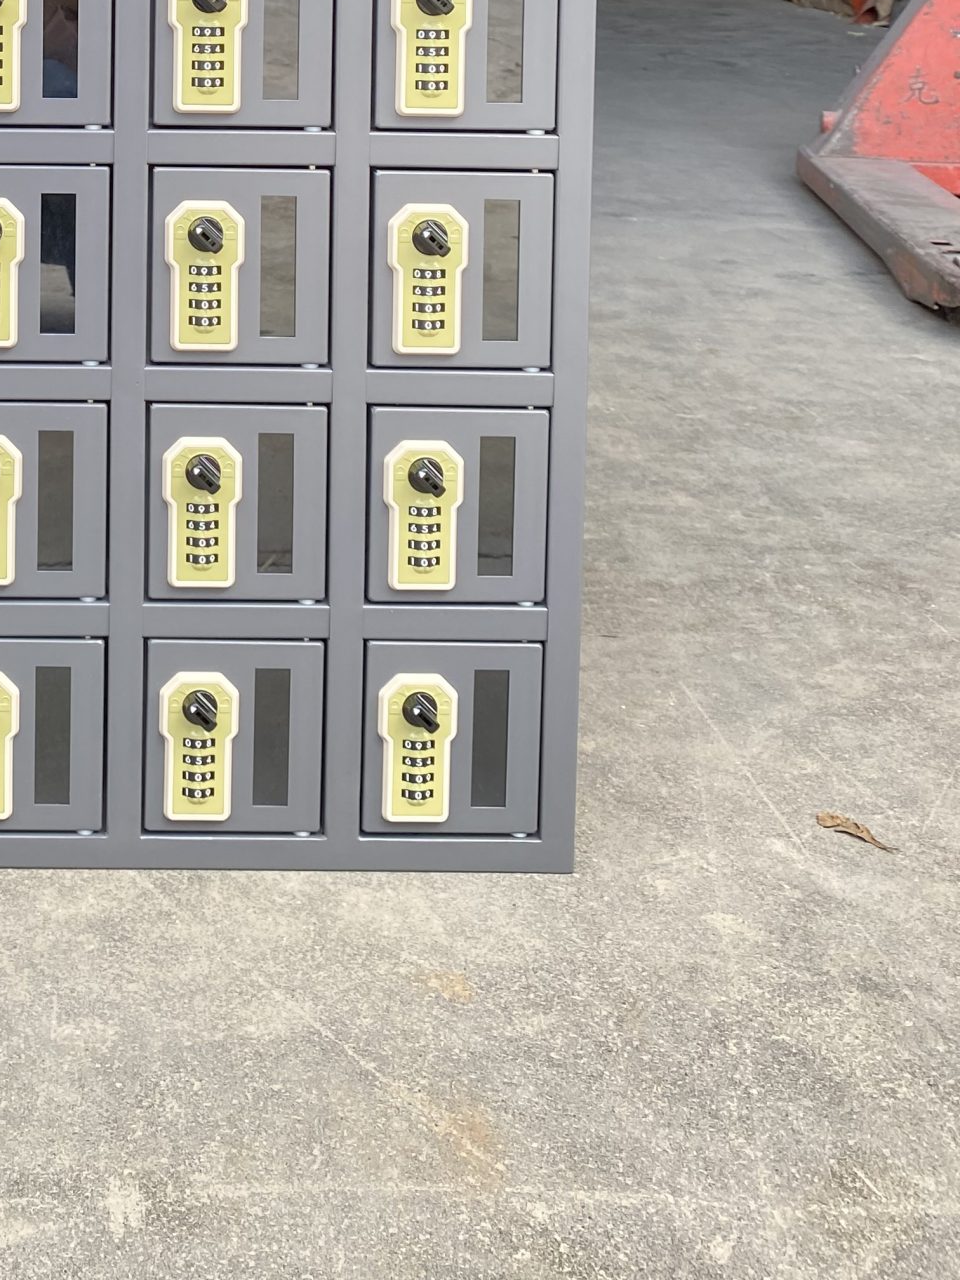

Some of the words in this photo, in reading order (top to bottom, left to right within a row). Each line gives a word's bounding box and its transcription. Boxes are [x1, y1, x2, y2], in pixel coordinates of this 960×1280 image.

[194, 28, 221, 37] 098
[193, 45, 221, 54] 654
[194, 62, 221, 70] 109
[194, 77, 221, 87] 109
[190, 265, 218, 277] 098
[190, 282, 218, 293] 654
[192, 299, 218, 310] 109
[192, 316, 218, 327] 109
[188, 503, 215, 515] 098
[188, 520, 215, 532] 654
[189, 537, 215, 548] 109
[189, 554, 215, 565] 109
[184, 737, 212, 750] 098
[185, 755, 212, 766] 654
[185, 771, 211, 783] 109
[185, 788, 211, 799] 109
